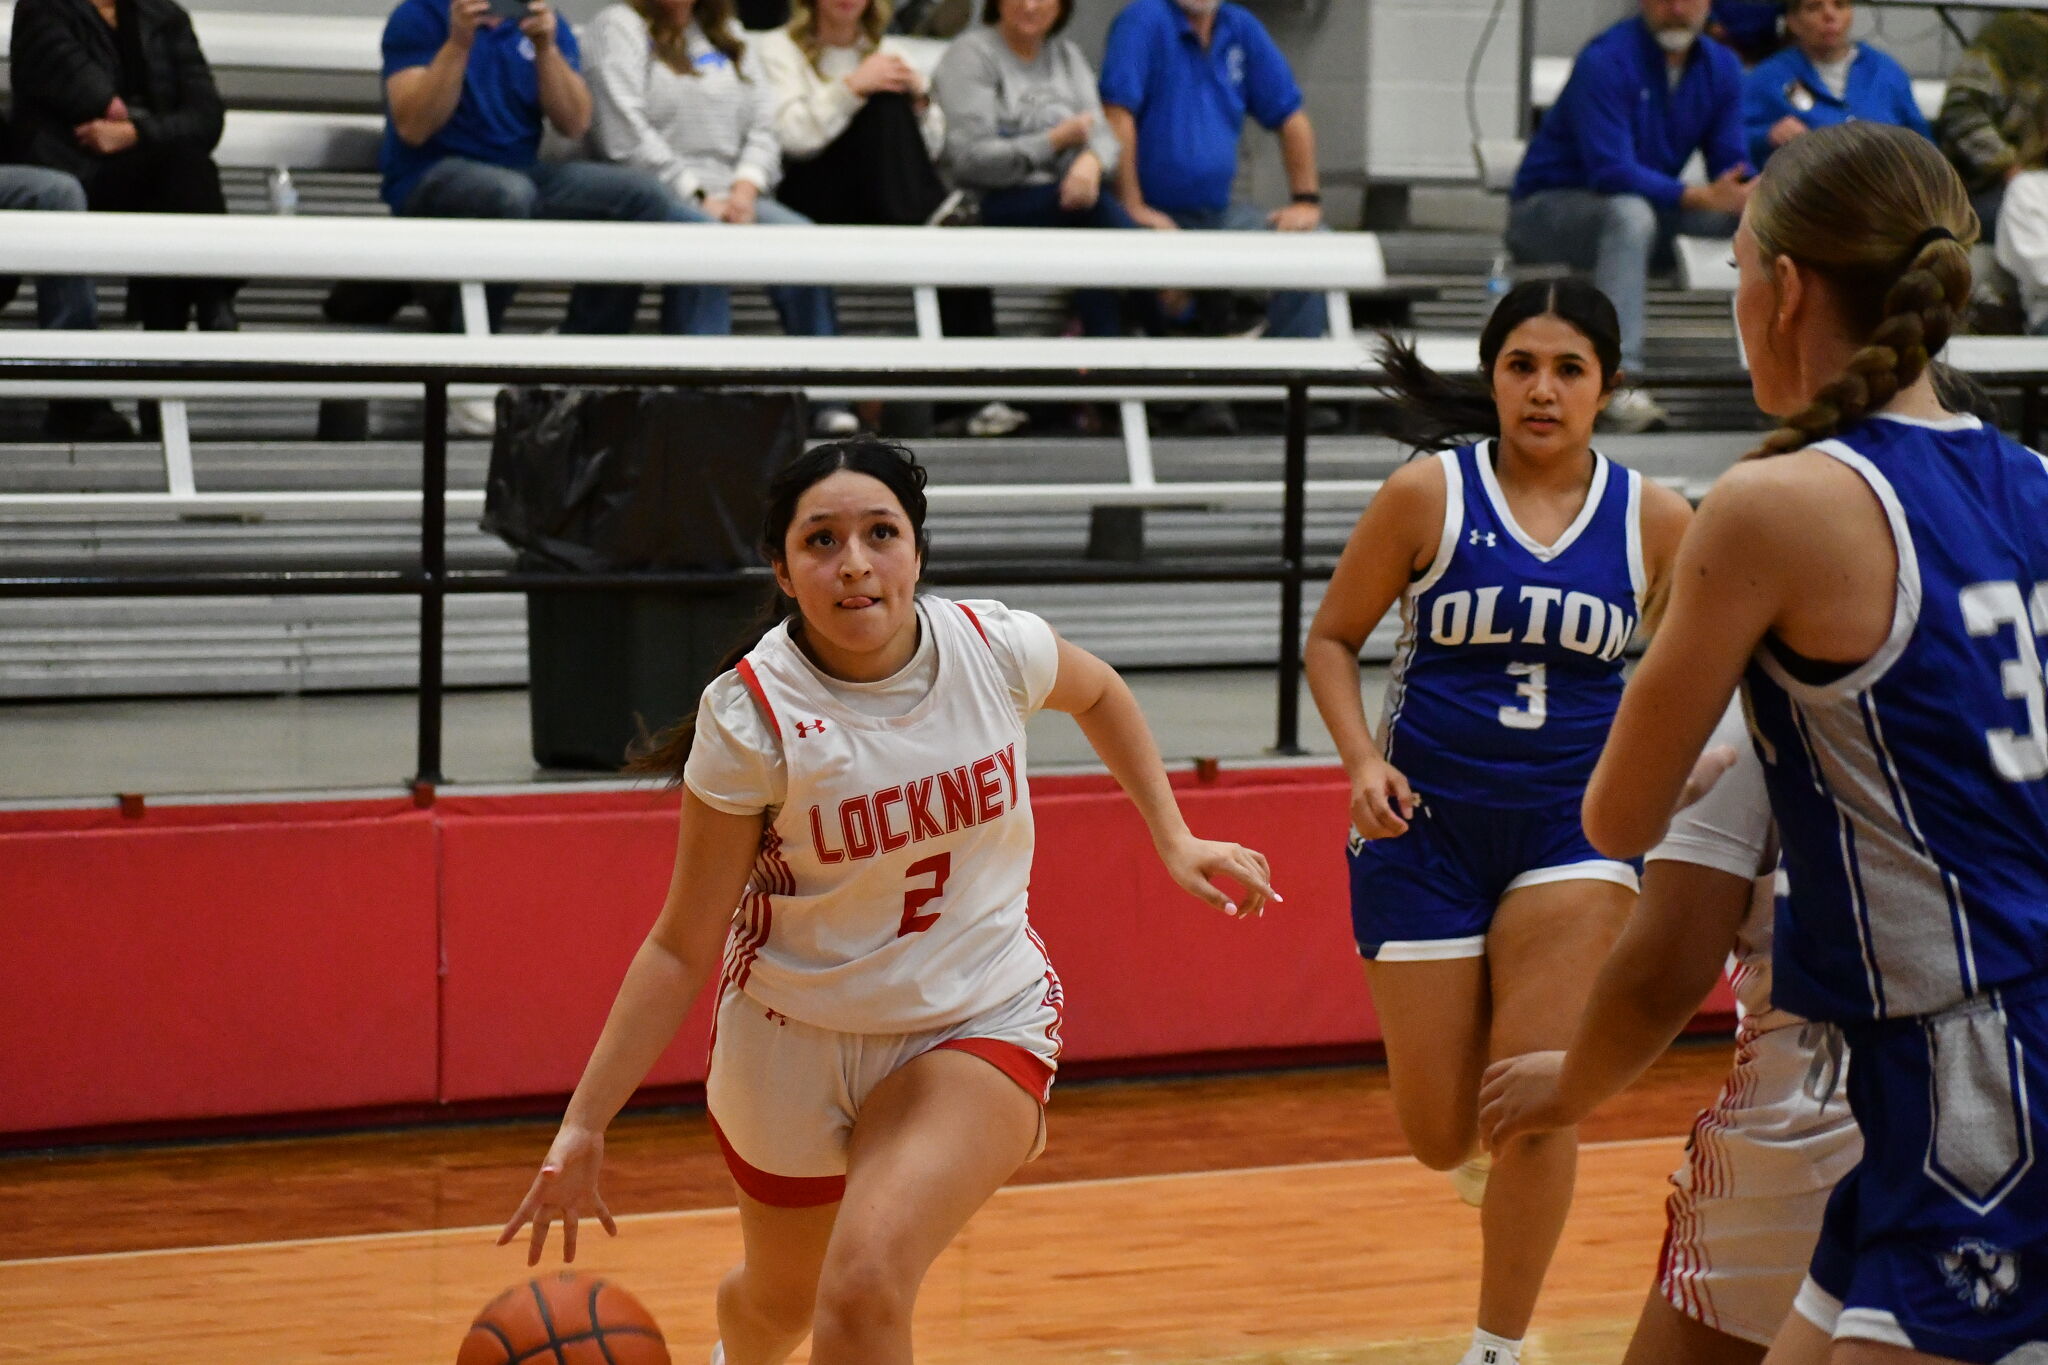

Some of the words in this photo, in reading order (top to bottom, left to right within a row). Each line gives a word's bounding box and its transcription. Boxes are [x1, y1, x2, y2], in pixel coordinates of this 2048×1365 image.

[1430, 585, 1634, 662] OLTON
[1498, 661, 1547, 730] 3
[809, 742, 1018, 864] LOCKNEY
[897, 851, 951, 938] 2
